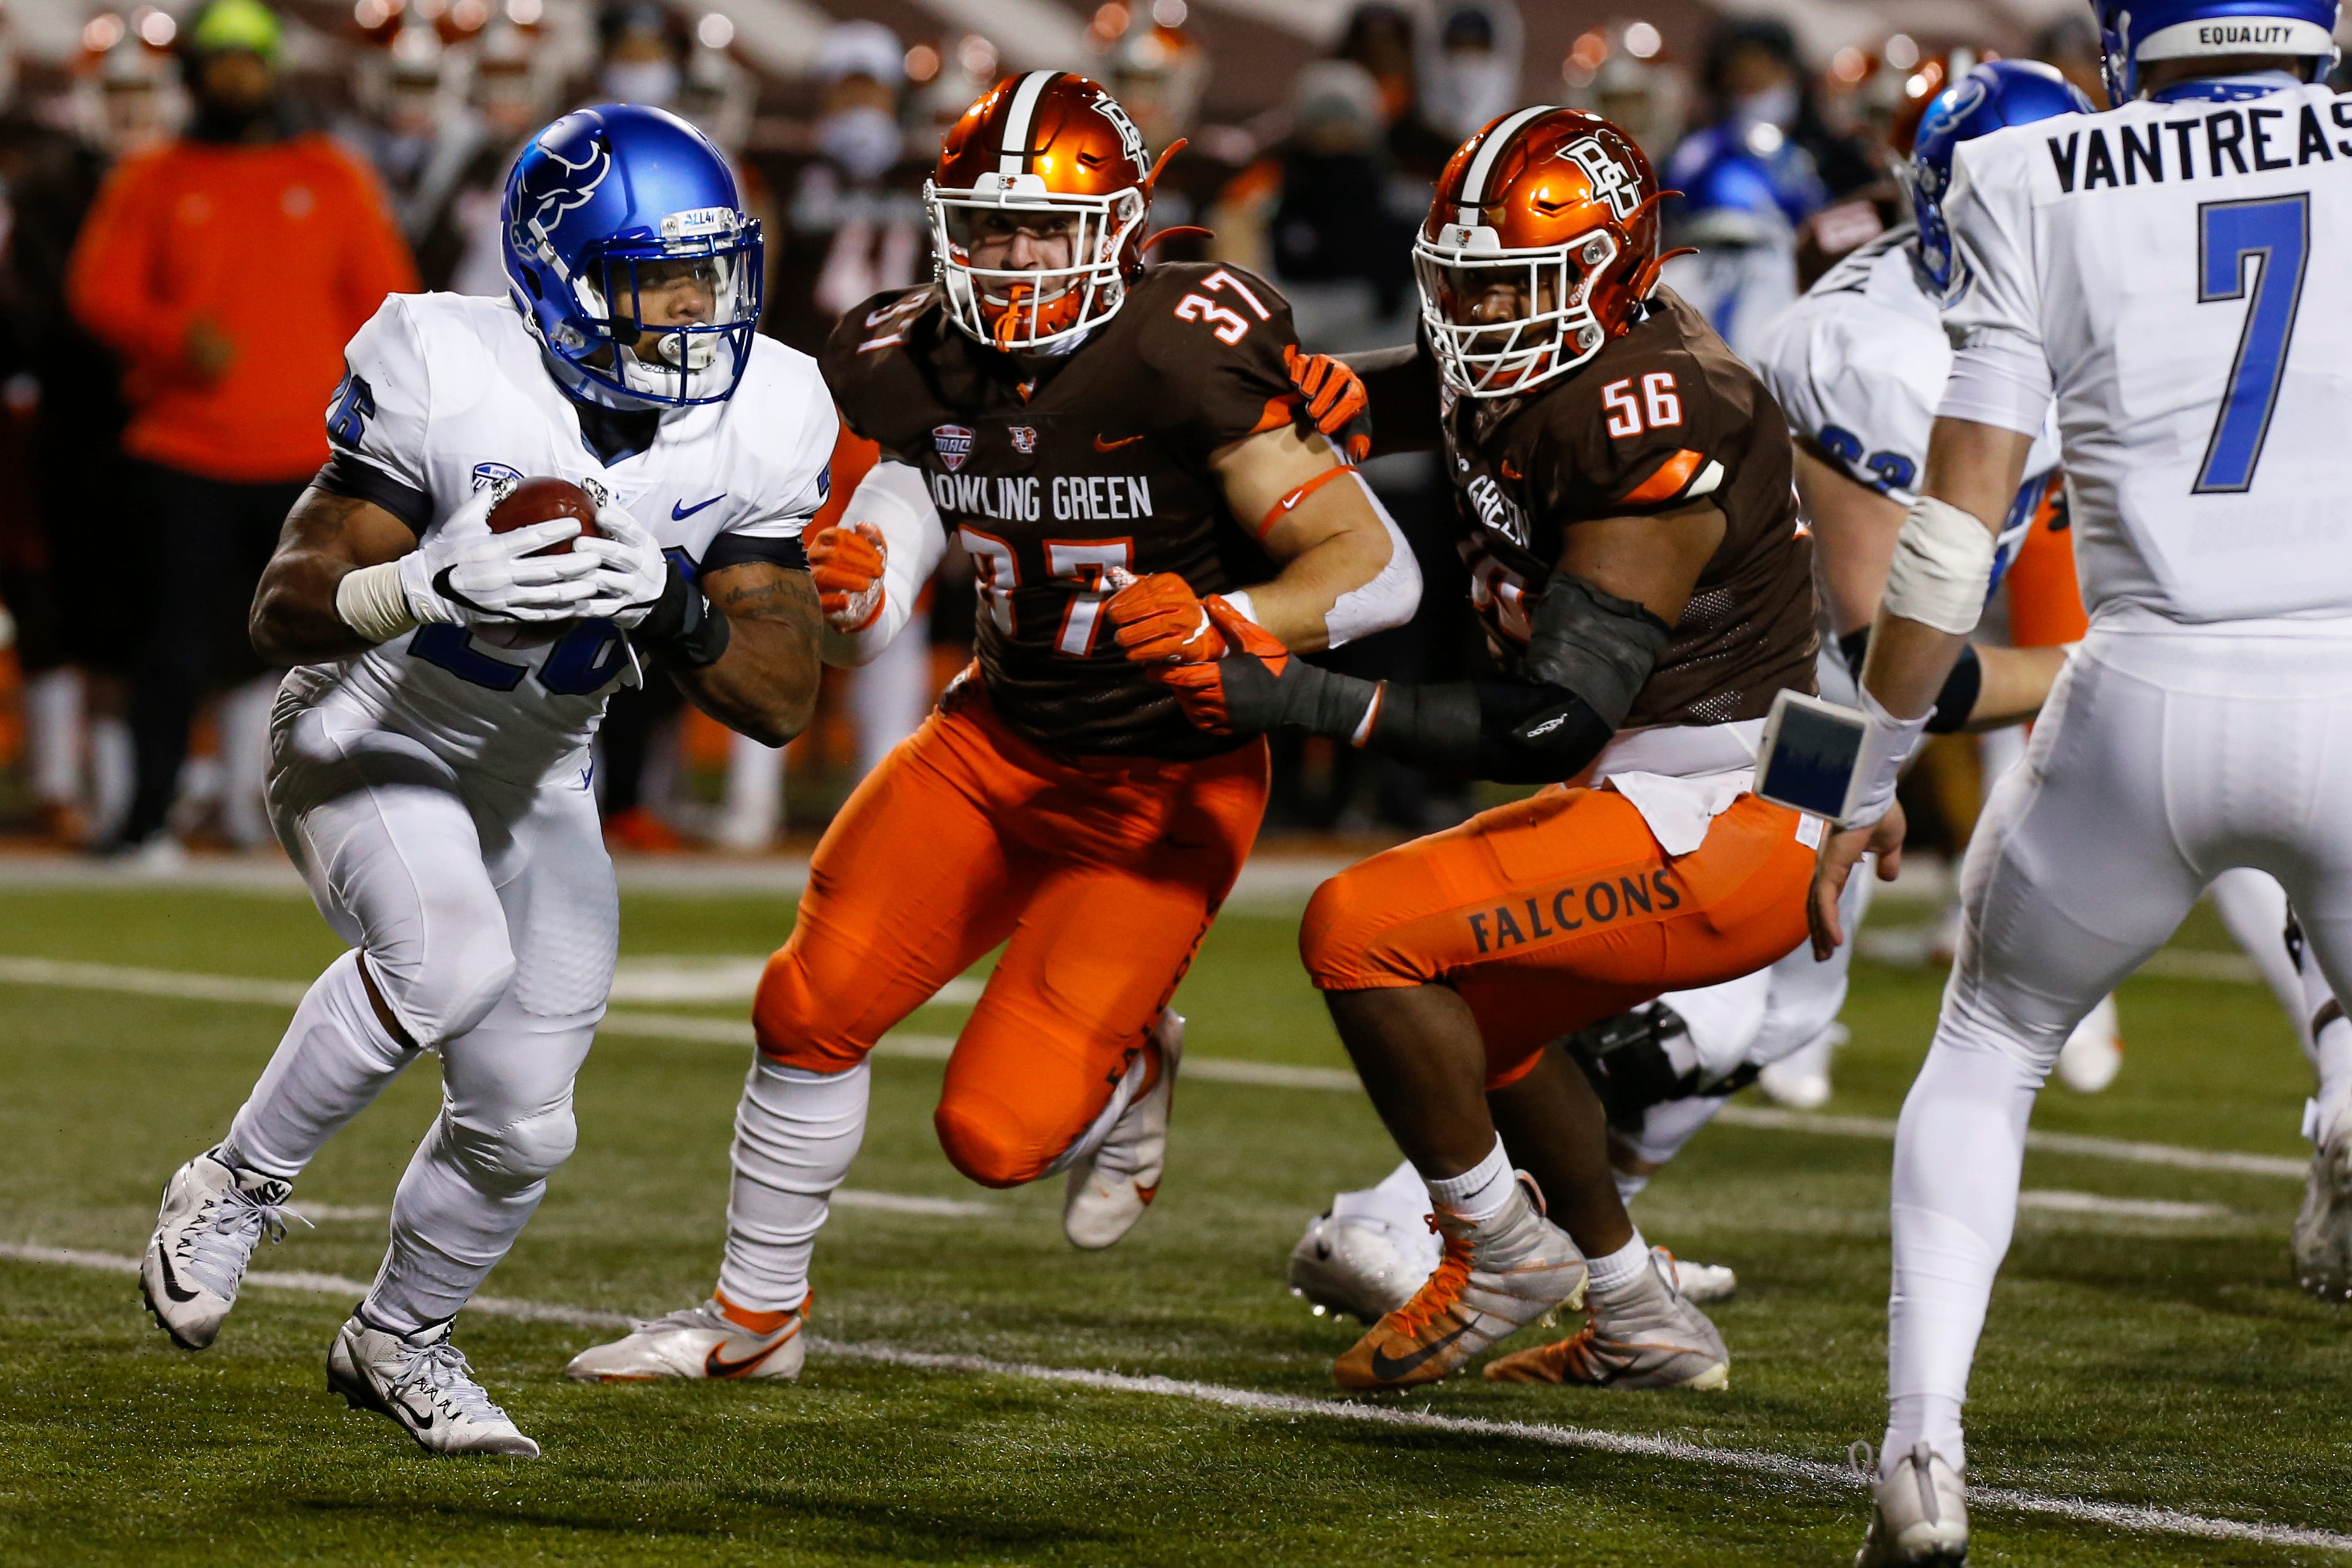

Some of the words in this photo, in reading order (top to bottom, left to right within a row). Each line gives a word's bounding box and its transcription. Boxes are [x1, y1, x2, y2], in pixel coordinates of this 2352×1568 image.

[2199, 27, 2294, 45] EQUALITY
[1173, 269, 1273, 347] 37
[2190, 191, 2310, 495] 7
[1601, 371, 1684, 439] 56
[935, 438, 971, 452] MAC
[930, 470, 1040, 521] OWLING
[1052, 476, 1153, 521] GREEN
[958, 523, 1135, 659] 37
[1468, 869, 1681, 954] FALCONS
